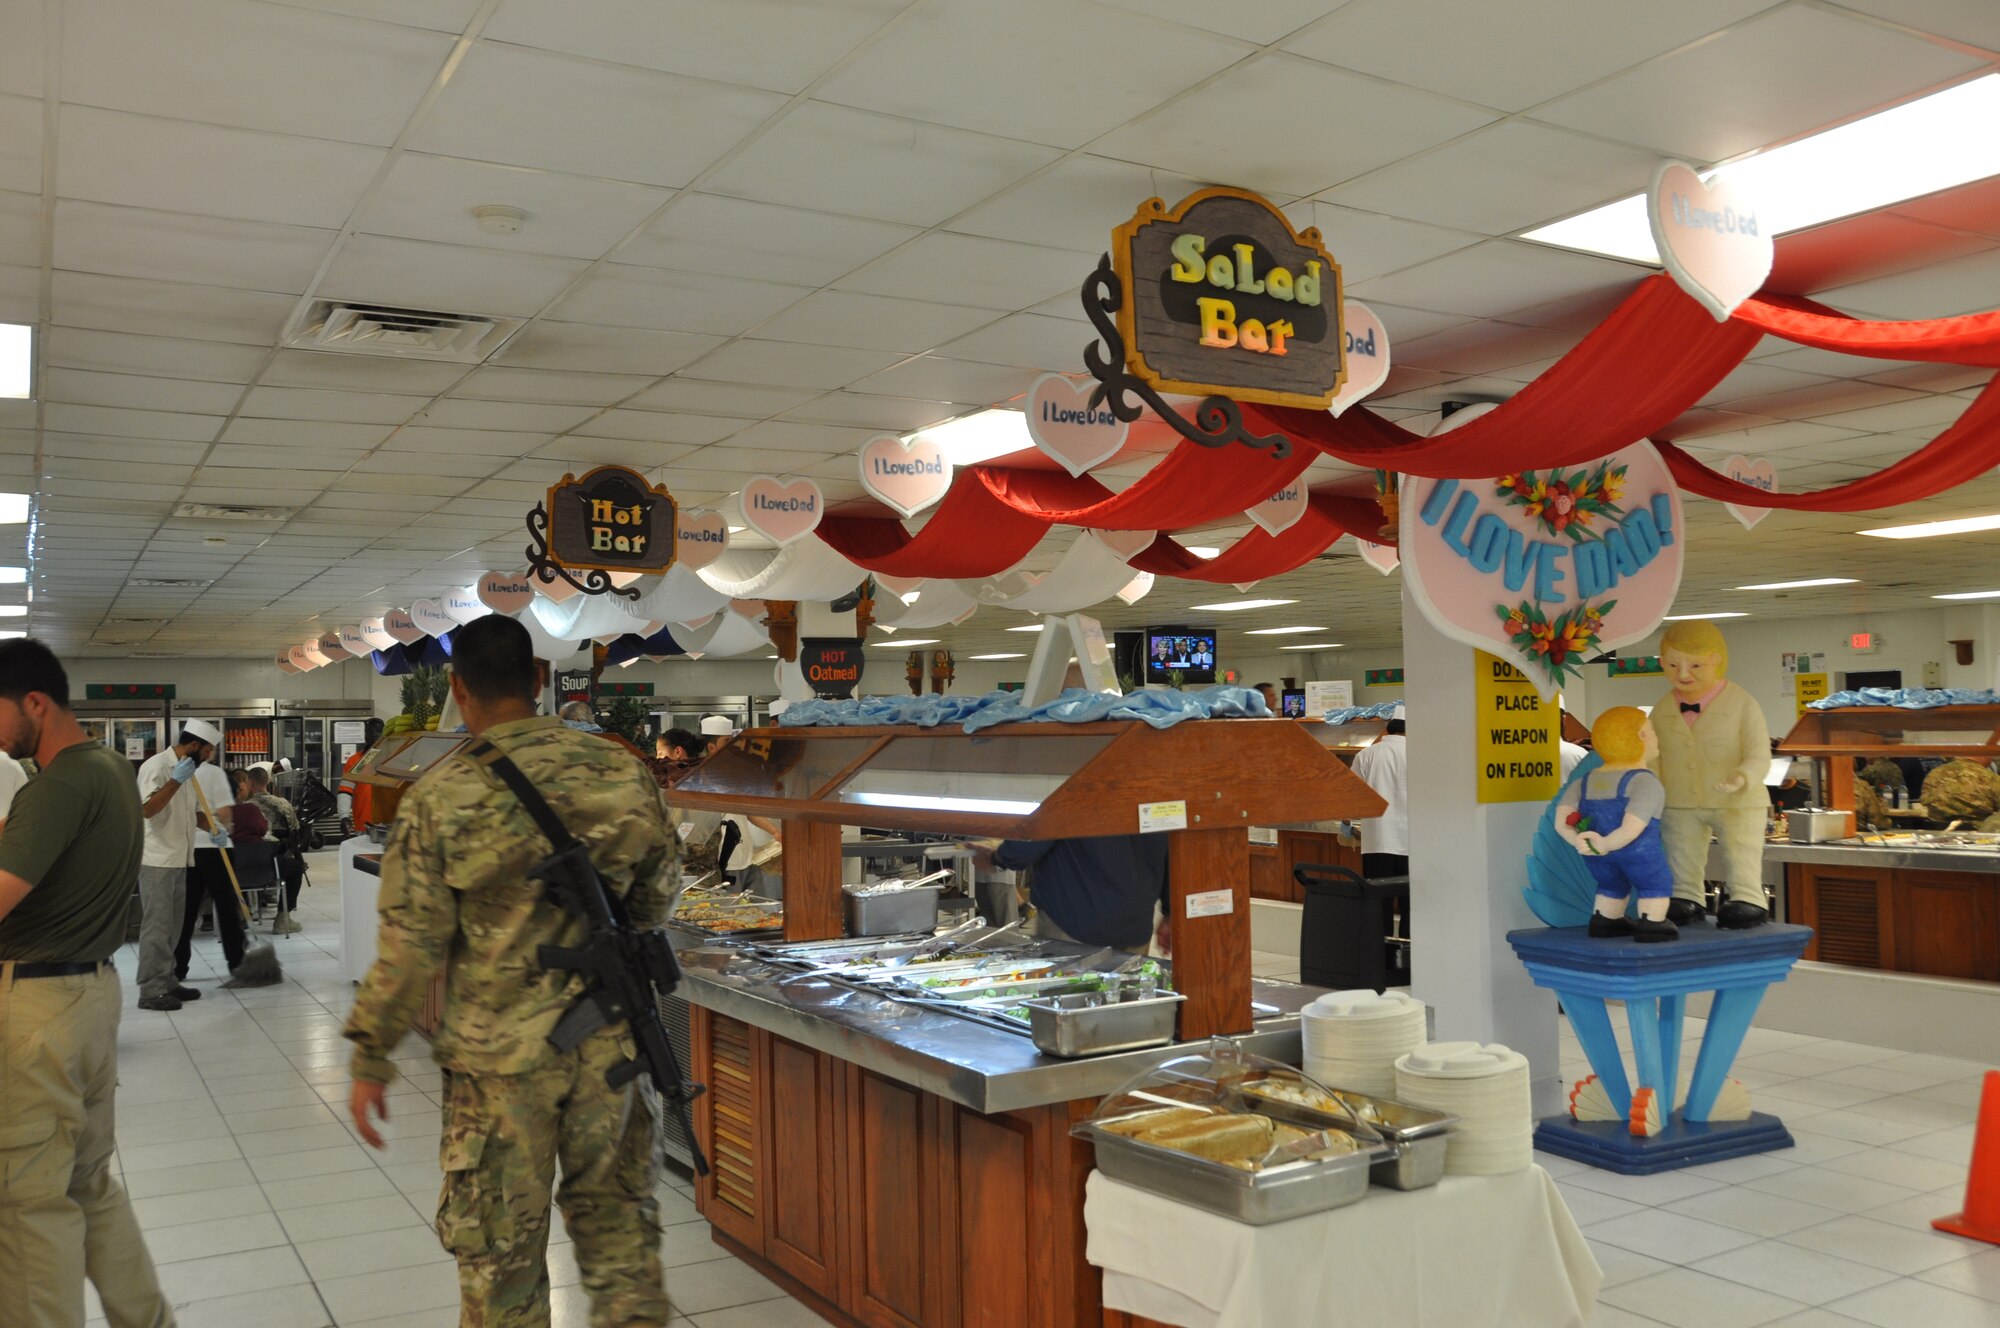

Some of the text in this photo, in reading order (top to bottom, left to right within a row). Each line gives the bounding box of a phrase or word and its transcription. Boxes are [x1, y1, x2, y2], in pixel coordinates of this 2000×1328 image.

[1196, 297, 1295, 356] Bar
[591, 499, 643, 526] Hot
[591, 526, 646, 553] Bar
[1420, 479, 1675, 603] I LOVE DAD!
[821, 651, 847, 663] HOT
[809, 664, 858, 681] Oatmeal
[1493, 661, 1512, 678] DO
[1495, 695, 1539, 711] PLACE
[1490, 728, 1548, 745] WEAPON
[1486, 761, 1553, 779] ON FLOOR
